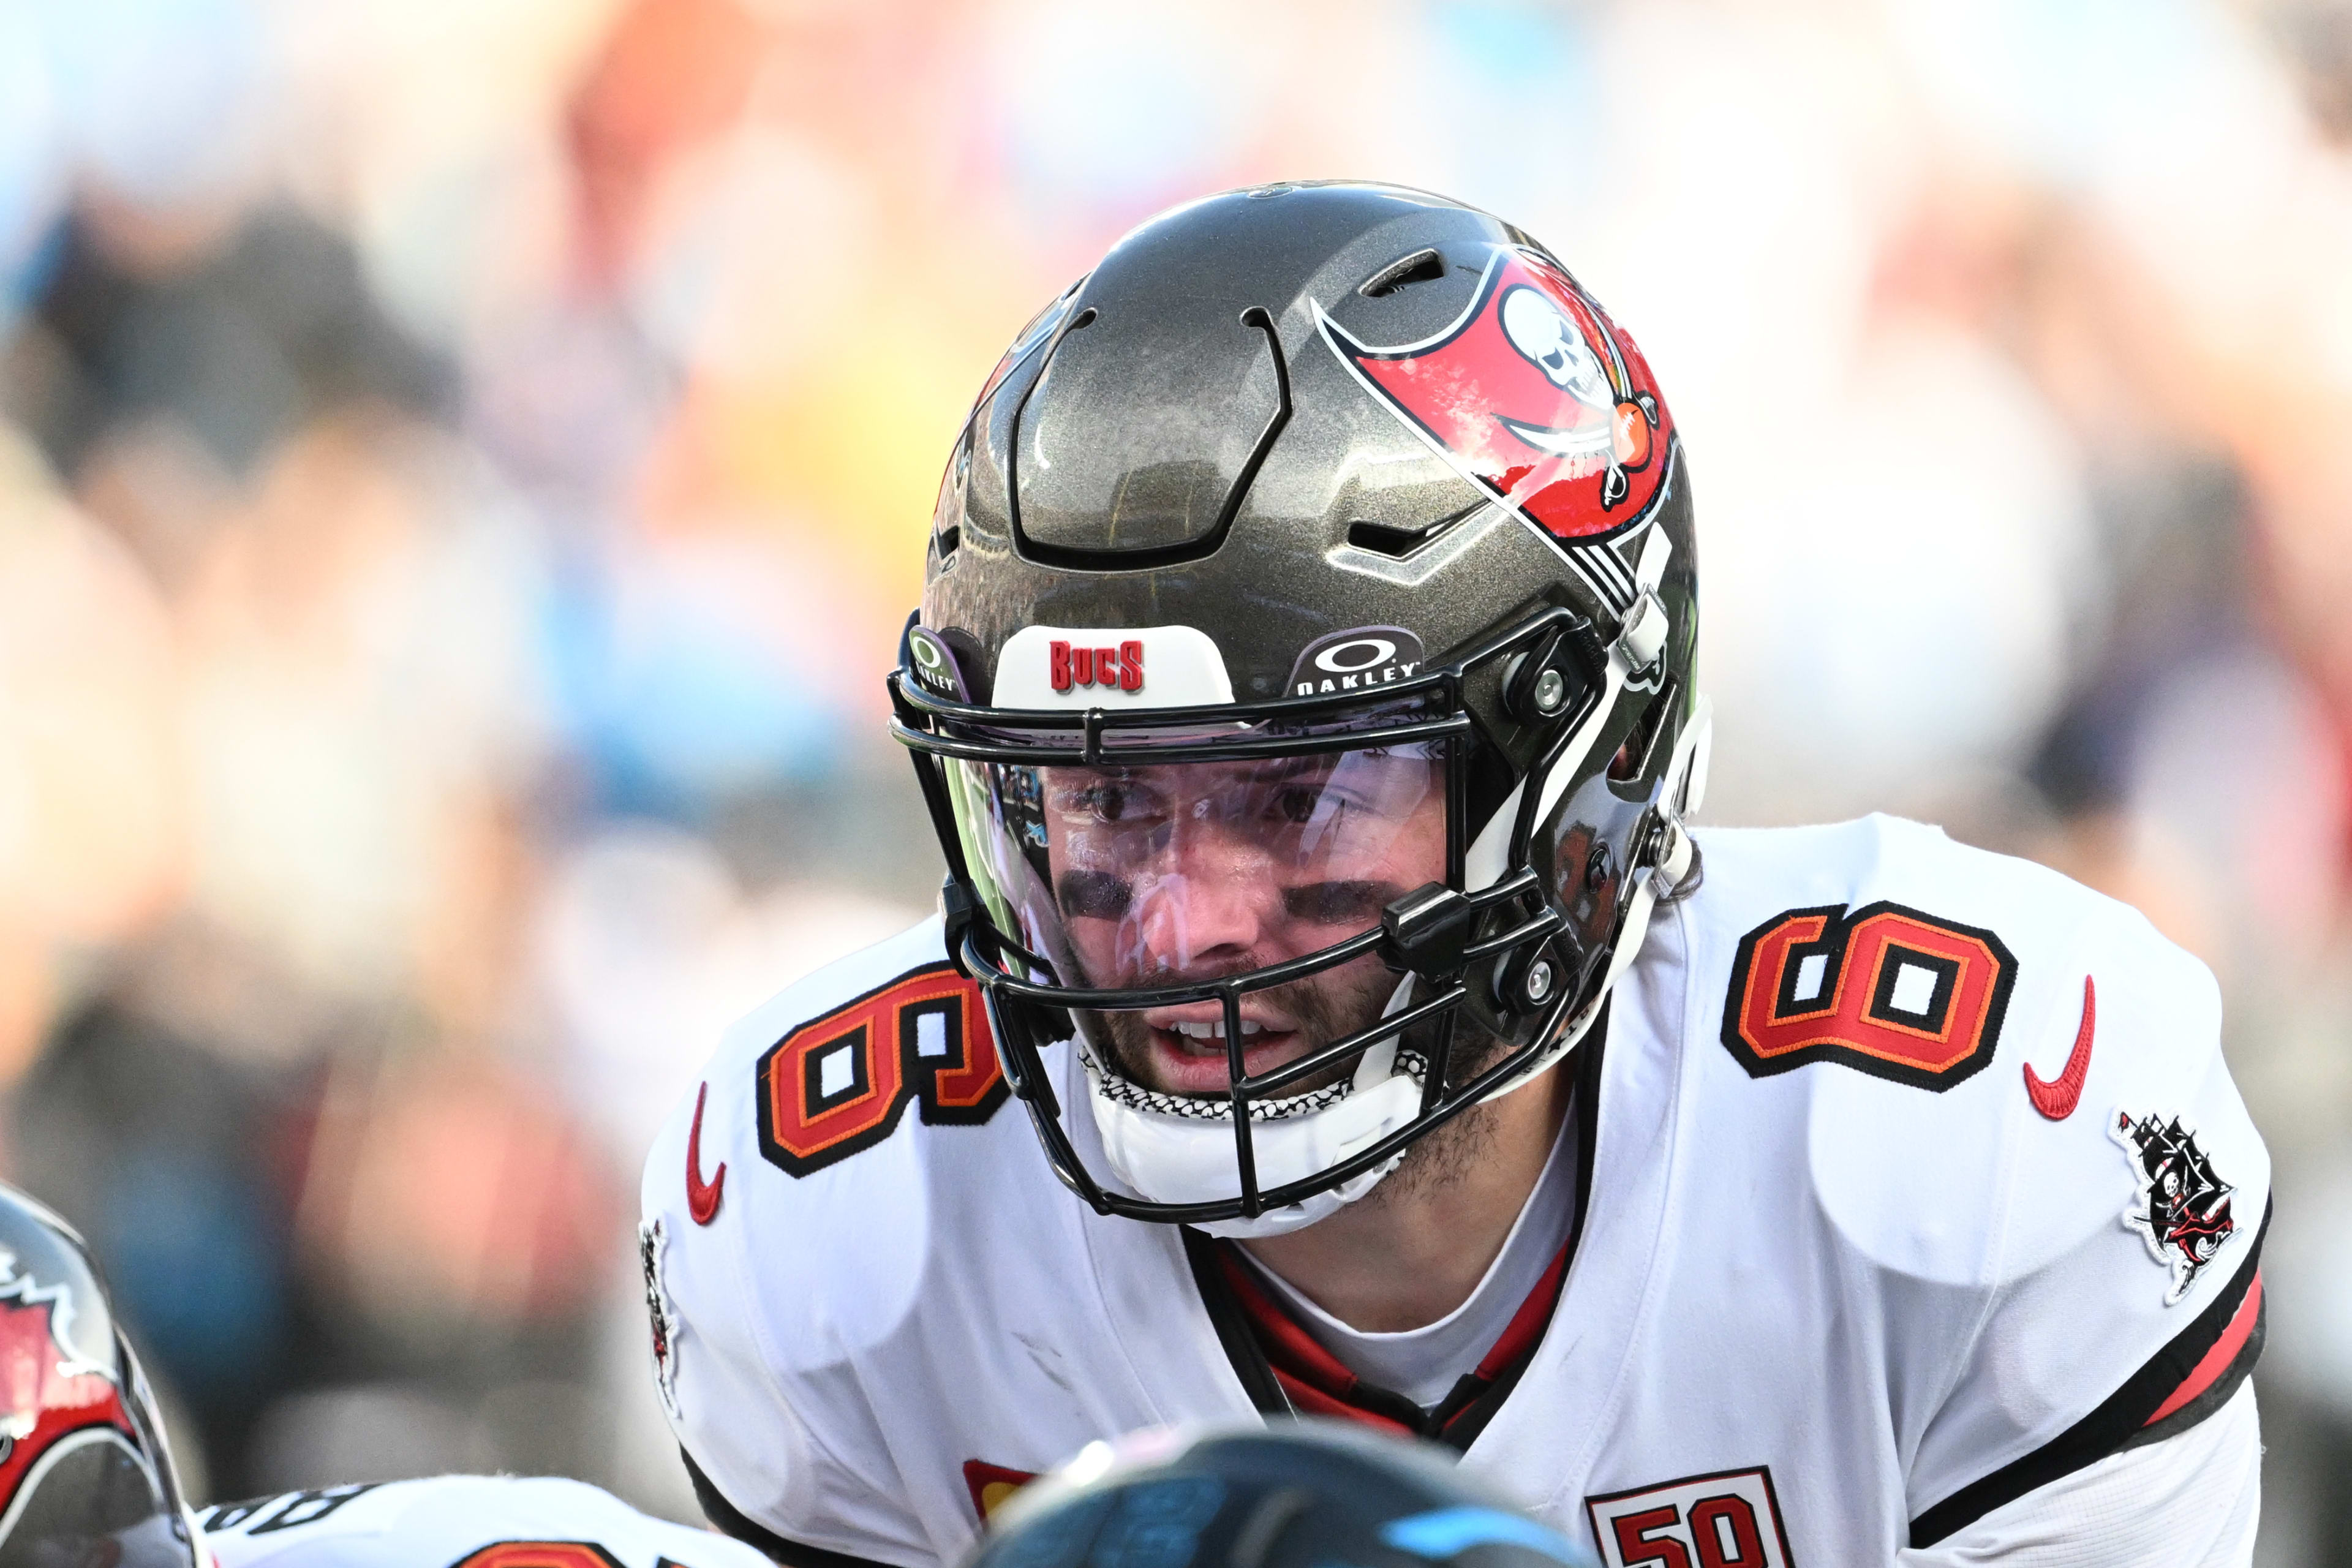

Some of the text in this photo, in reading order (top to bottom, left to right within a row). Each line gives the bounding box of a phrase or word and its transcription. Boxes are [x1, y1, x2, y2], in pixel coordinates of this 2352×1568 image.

[1297, 663, 1415, 696] OAKLEY
[1720, 899, 2019, 1094] 6
[755, 959, 1014, 1180] 6
[1610, 1493, 1770, 1568] 50
